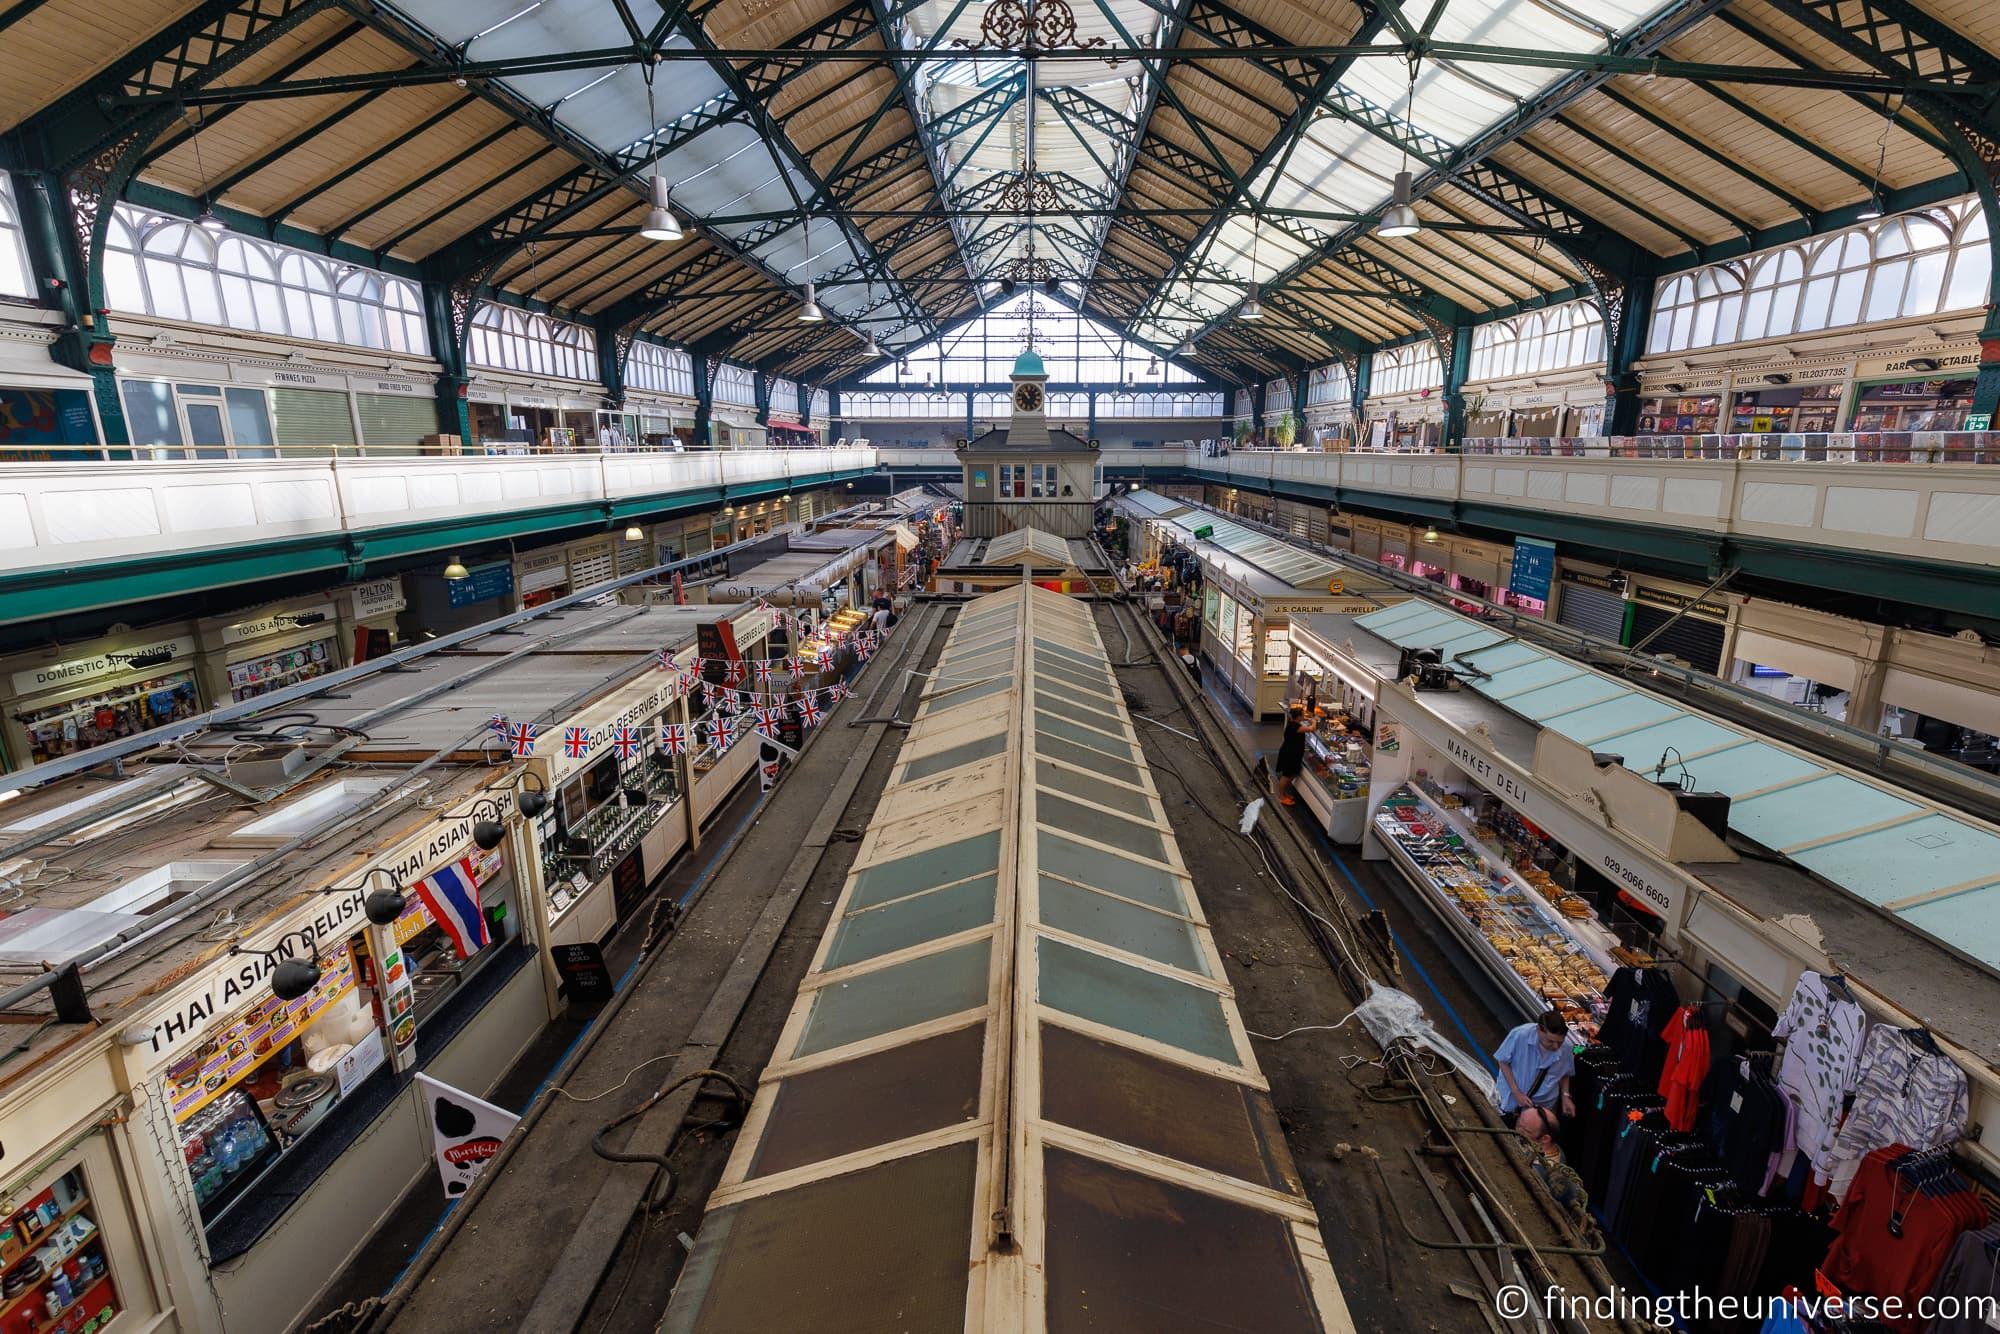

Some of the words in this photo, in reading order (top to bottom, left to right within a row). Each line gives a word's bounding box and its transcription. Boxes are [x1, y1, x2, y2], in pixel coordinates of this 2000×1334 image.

[301, 375, 316, 384] PIZZA
[1701, 379, 1723, 388] VIDEOS
[360, 582, 393, 598] PILTON
[727, 586, 746, 598] On
[238, 622, 266, 636] TOOLS
[735, 627, 758, 648] ESERVES
[36, 660, 105, 684] DOMESTIC
[588, 723, 615, 751] GOLD
[616, 693, 659, 728] RESERVES
[660, 683, 673, 702] LTD
[1447, 739, 1491, 778] MARKET
[1496, 773, 1527, 804] DELI
[429, 822, 470, 861] ASIAN
[1604, 856, 1621, 874] 029
[1622, 867, 1644, 891] 2066
[1645, 882, 1670, 910] 6603
[151, 992, 214, 1053] THAI
[223, 938, 295, 1005] ASIAN
[301, 889, 366, 949] DELISH
[159, 956, 204, 987] FRAGILE
